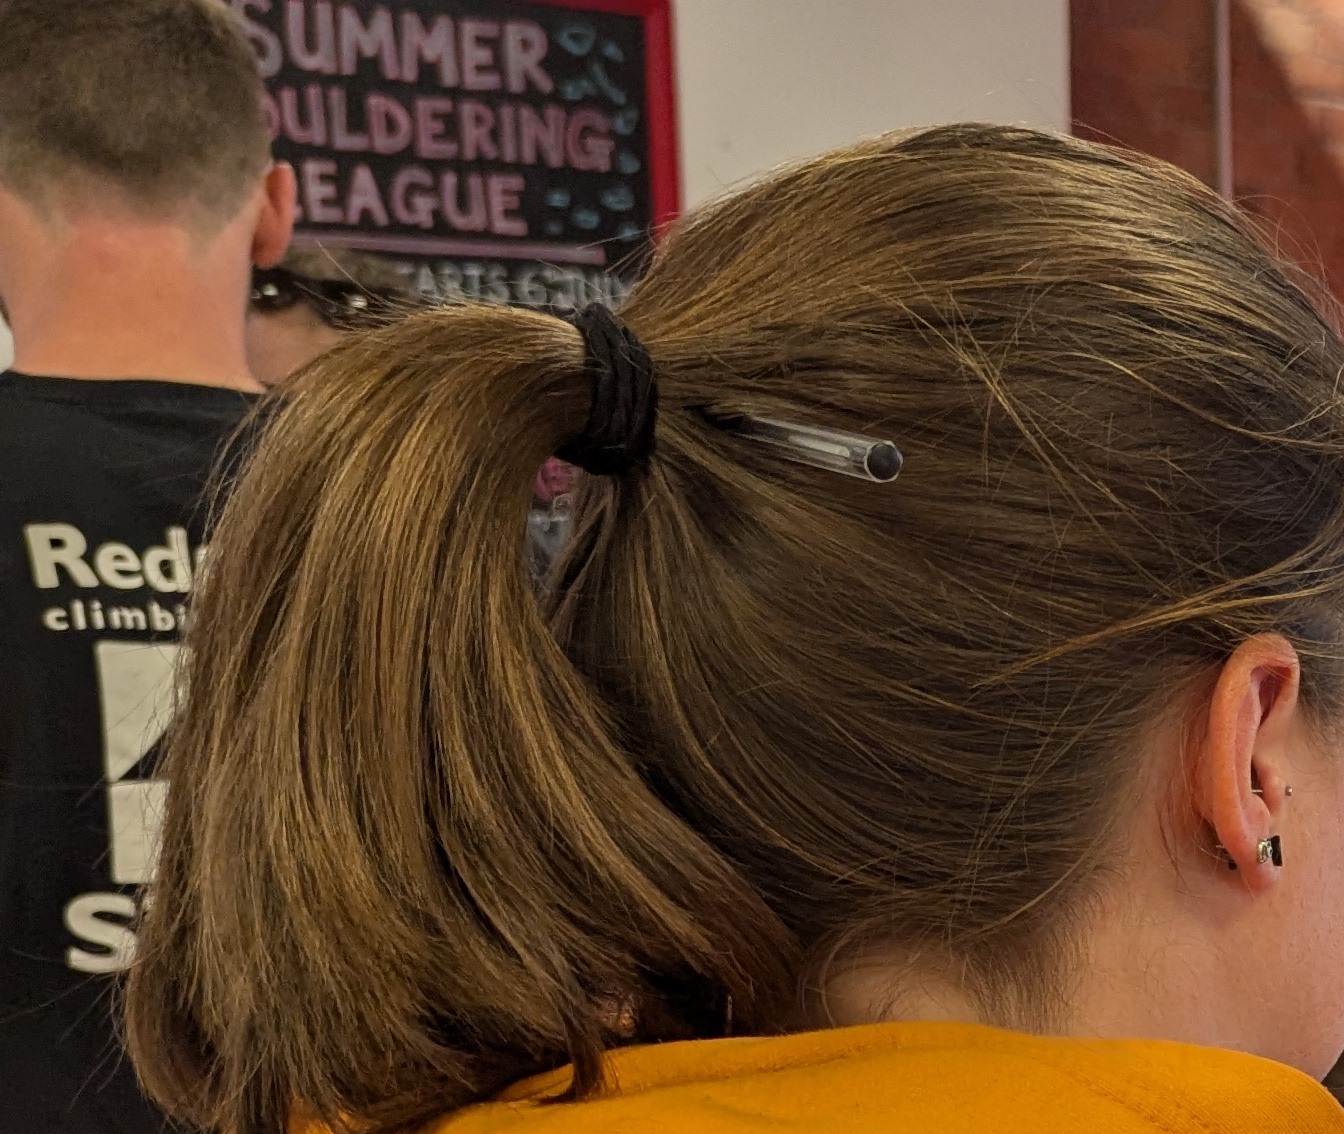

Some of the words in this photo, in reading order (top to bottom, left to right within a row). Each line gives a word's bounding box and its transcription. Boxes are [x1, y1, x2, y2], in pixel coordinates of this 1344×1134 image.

[243, 0, 553, 94] SUMMER
[264, 83, 615, 173] ULDERING
[293, 158, 528, 237] EAGUE
[23, 521, 208, 594] Red
